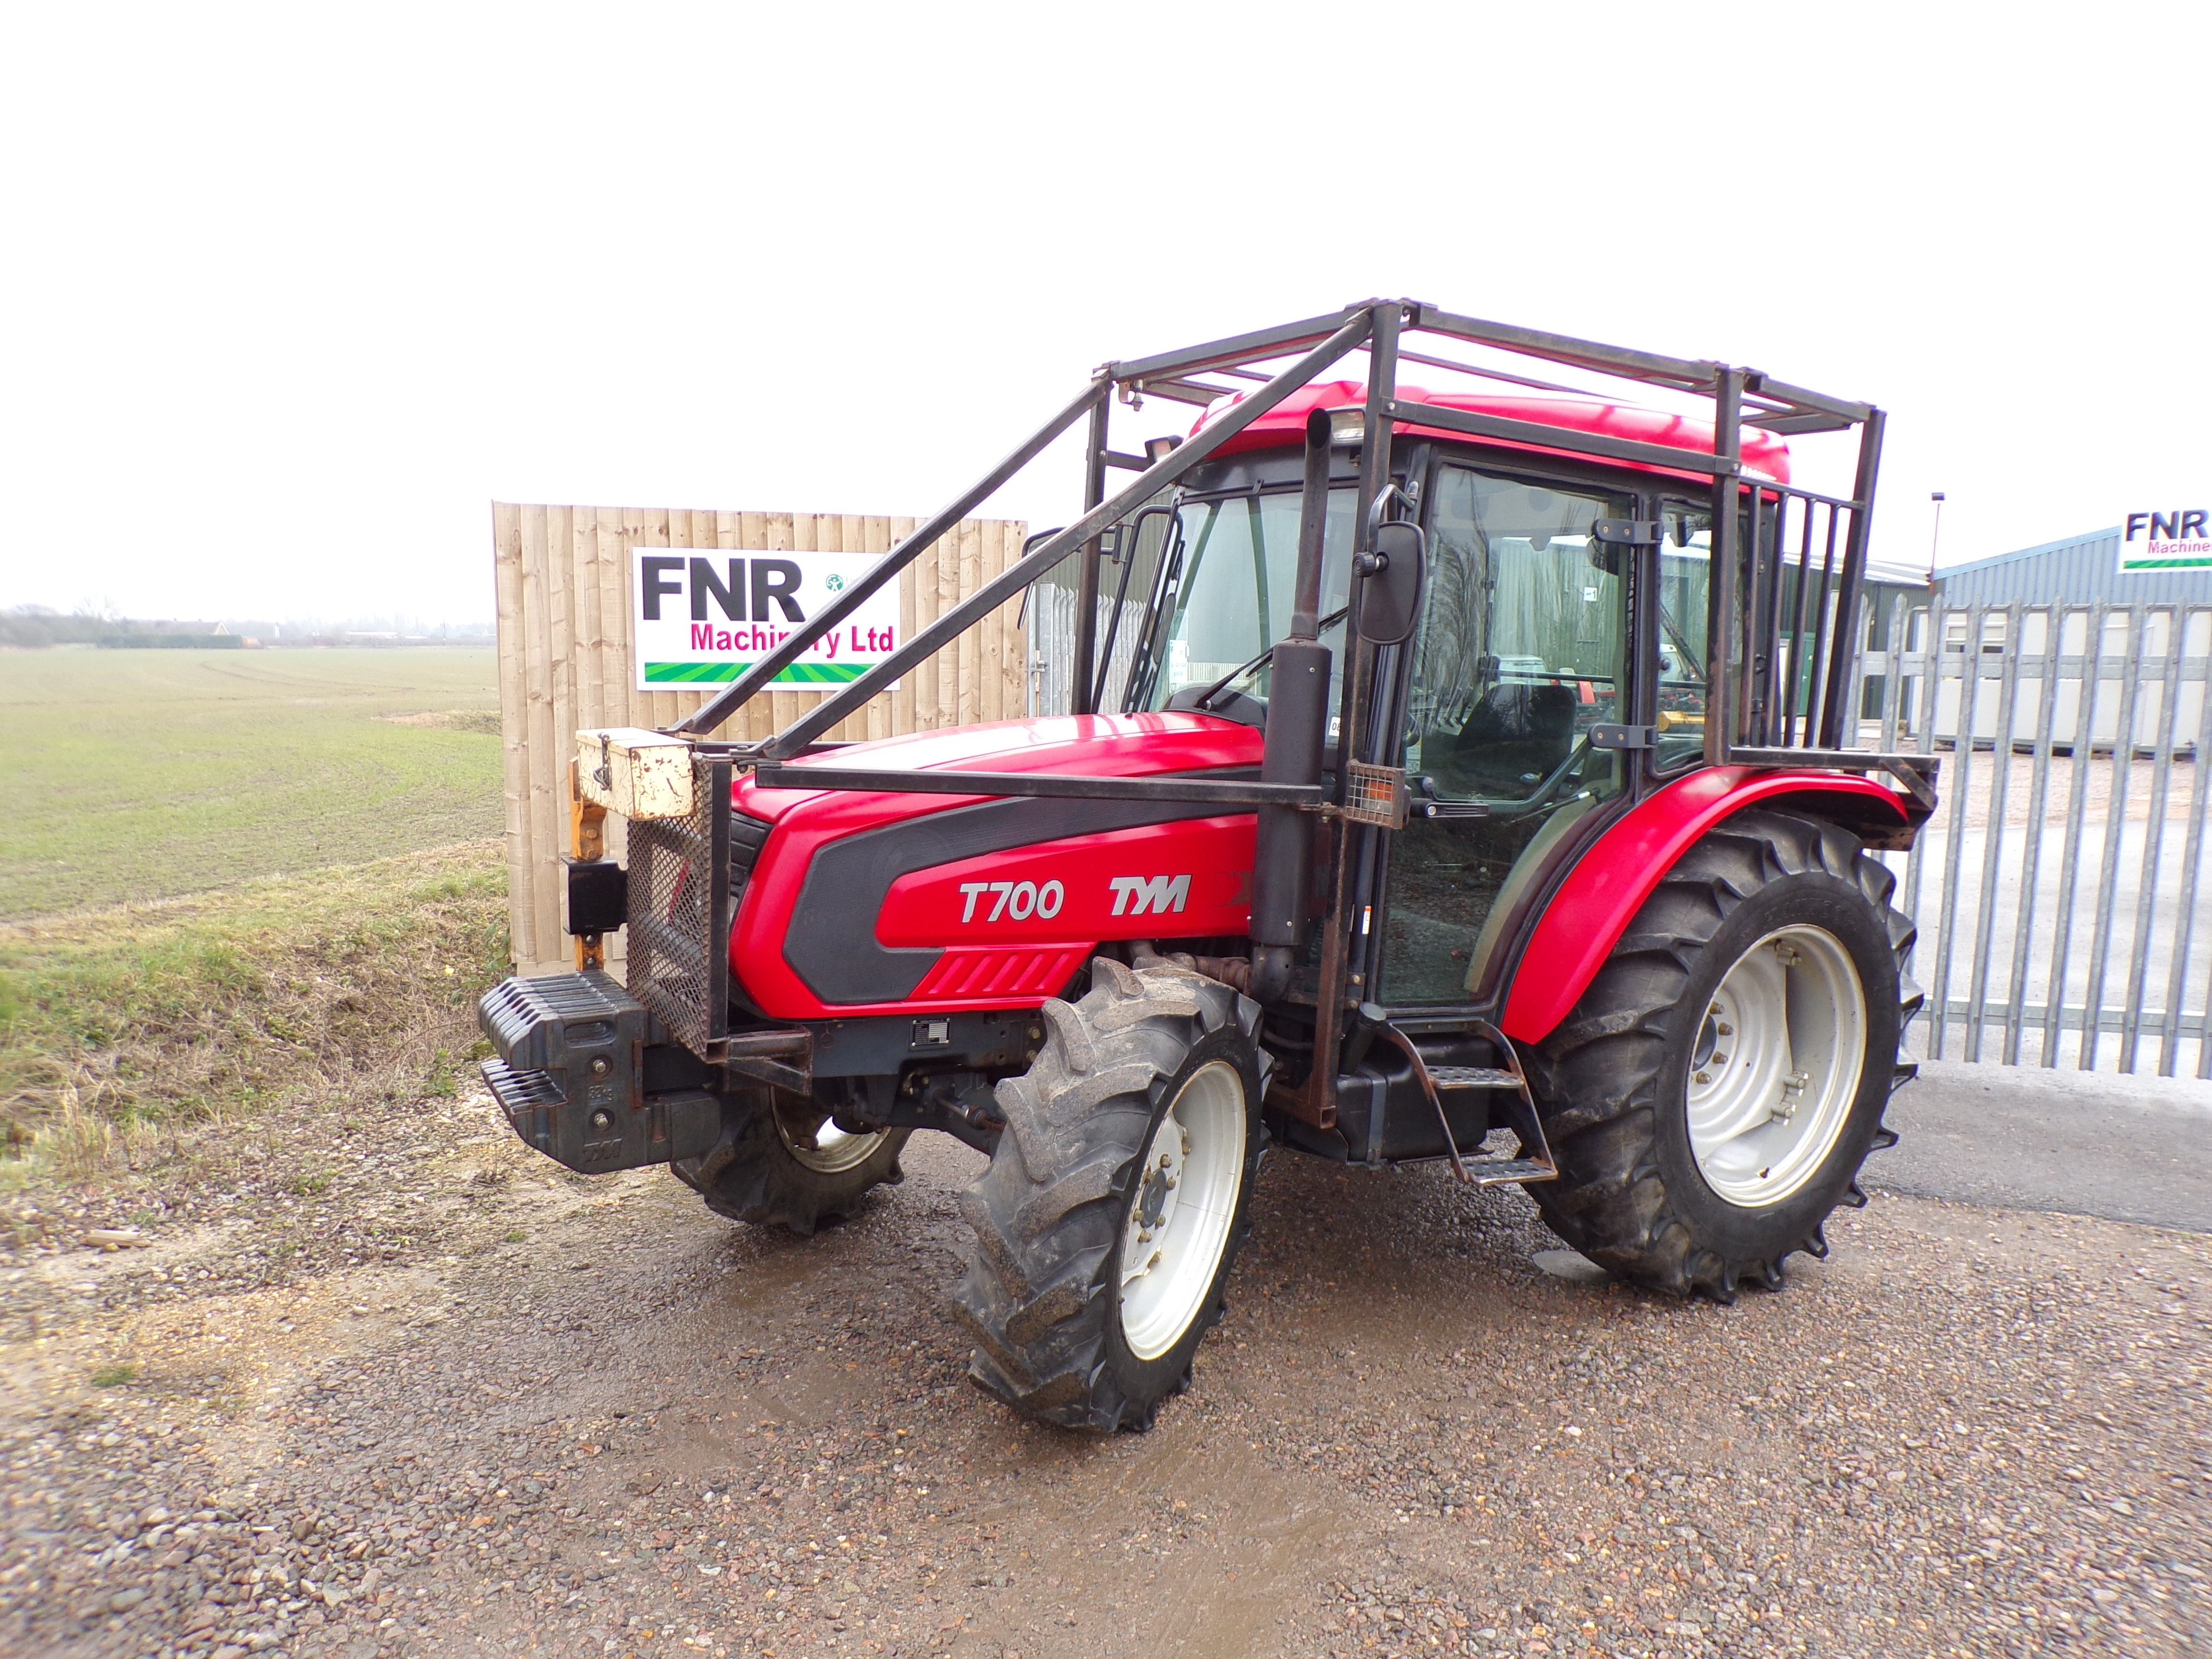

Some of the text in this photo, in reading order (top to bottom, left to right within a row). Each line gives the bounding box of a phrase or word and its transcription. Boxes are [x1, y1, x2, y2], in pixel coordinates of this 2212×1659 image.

[2126, 509, 2209, 541] FNR
[2148, 540, 2212, 553] Machine
[642, 556, 806, 622] FNR
[691, 624, 893, 658] Machiy Ltd
[960, 879, 1064, 923] T700
[1109, 874, 1192, 916] TYM
